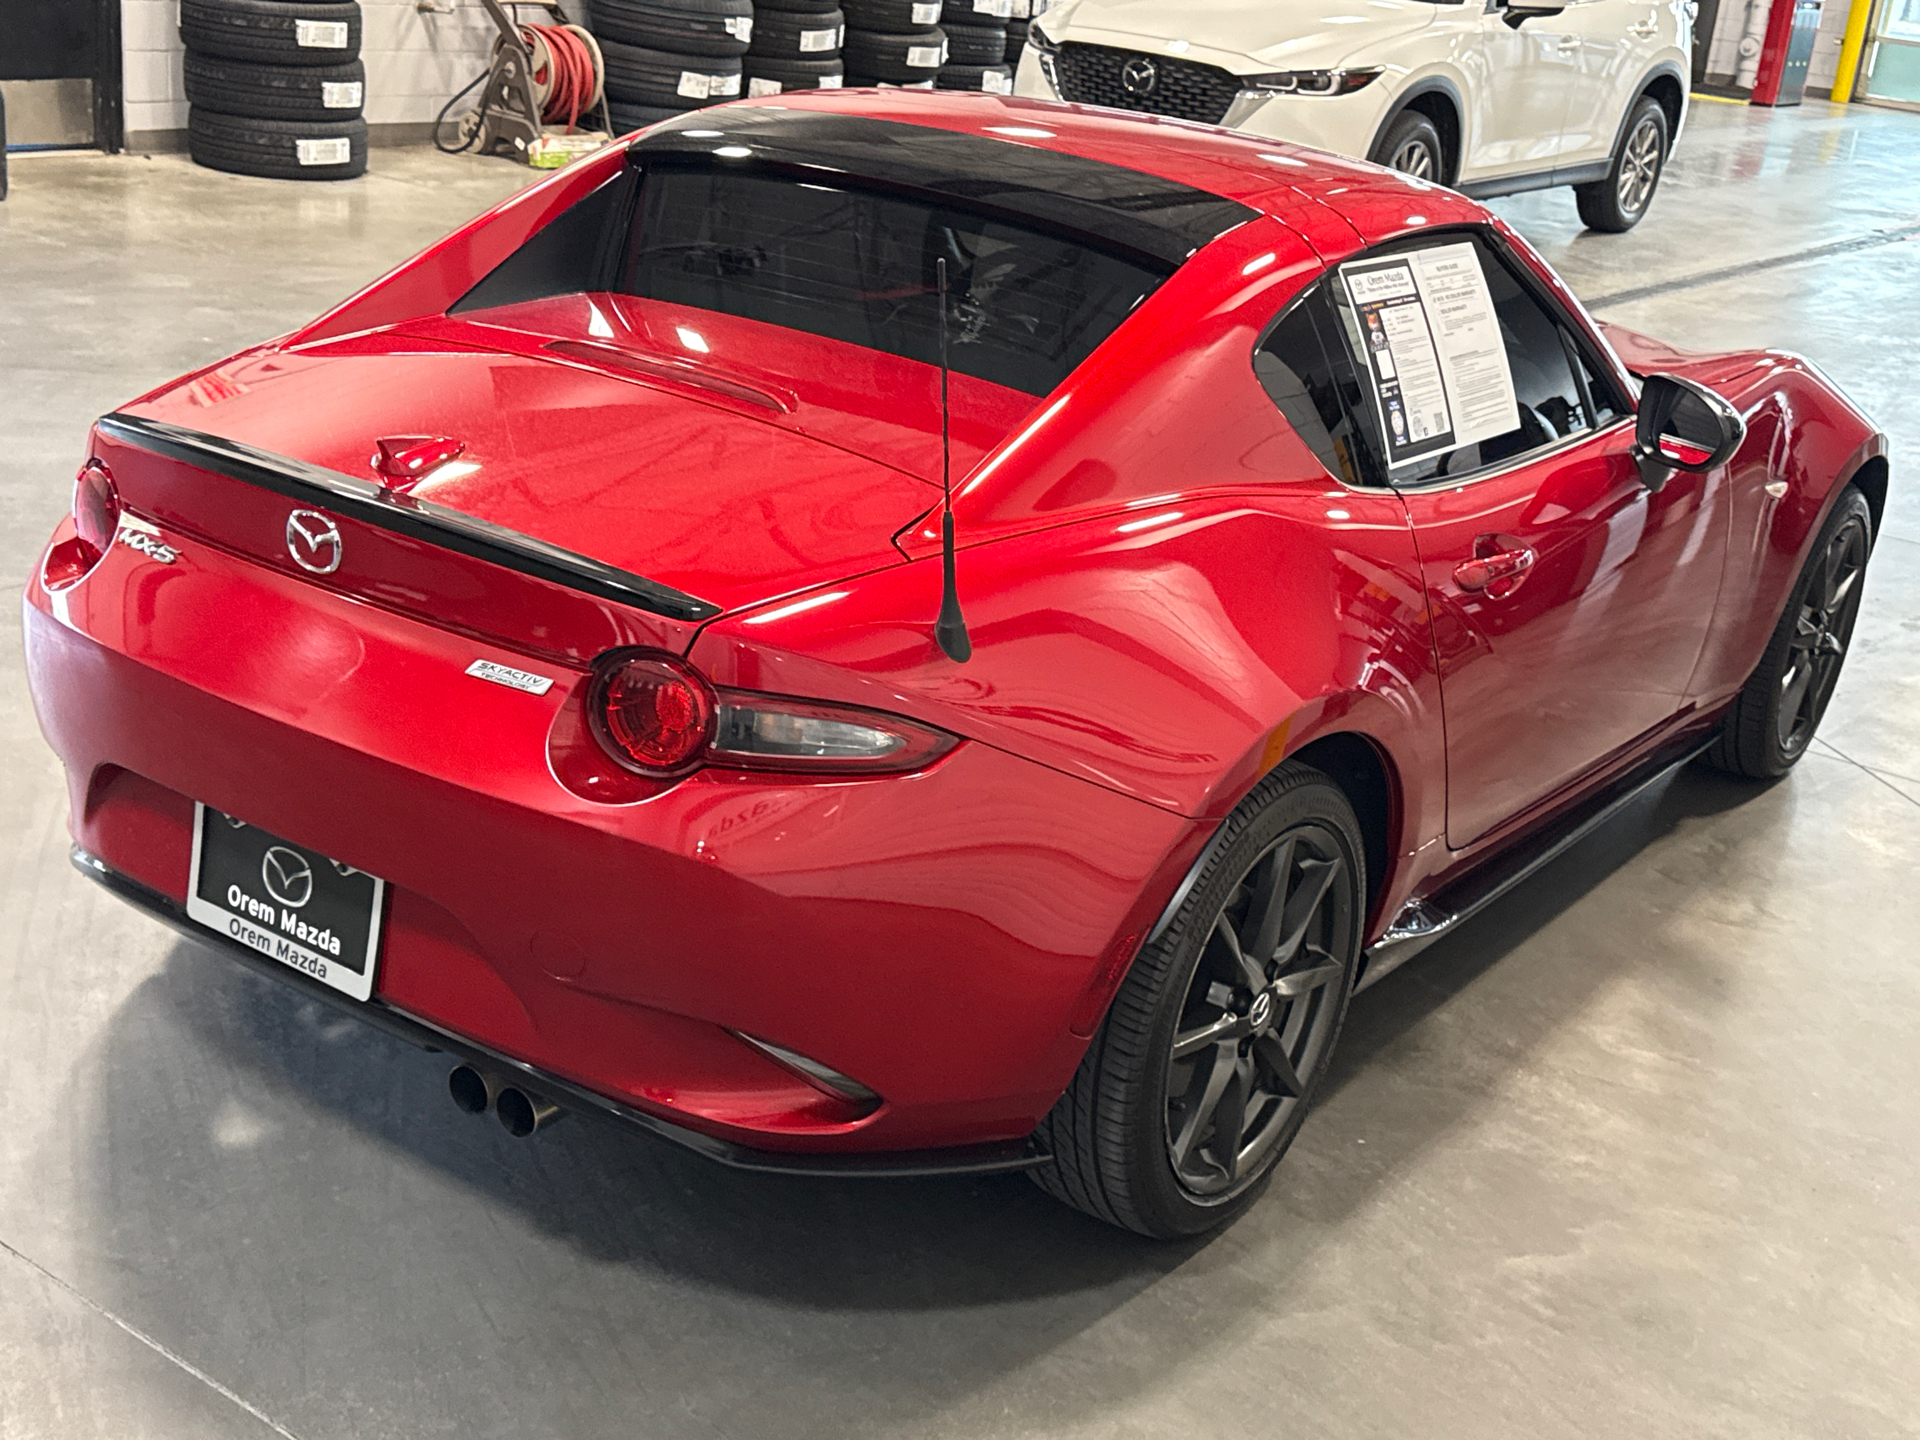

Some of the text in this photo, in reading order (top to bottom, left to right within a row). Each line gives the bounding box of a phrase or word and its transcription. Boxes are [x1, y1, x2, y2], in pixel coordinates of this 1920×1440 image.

[118, 528, 182, 563] MX-5
[478, 662, 543, 684] SKYACTIV
[228, 884, 341, 956] Orem Mazda
[229, 918, 327, 979] Orem Mazda
